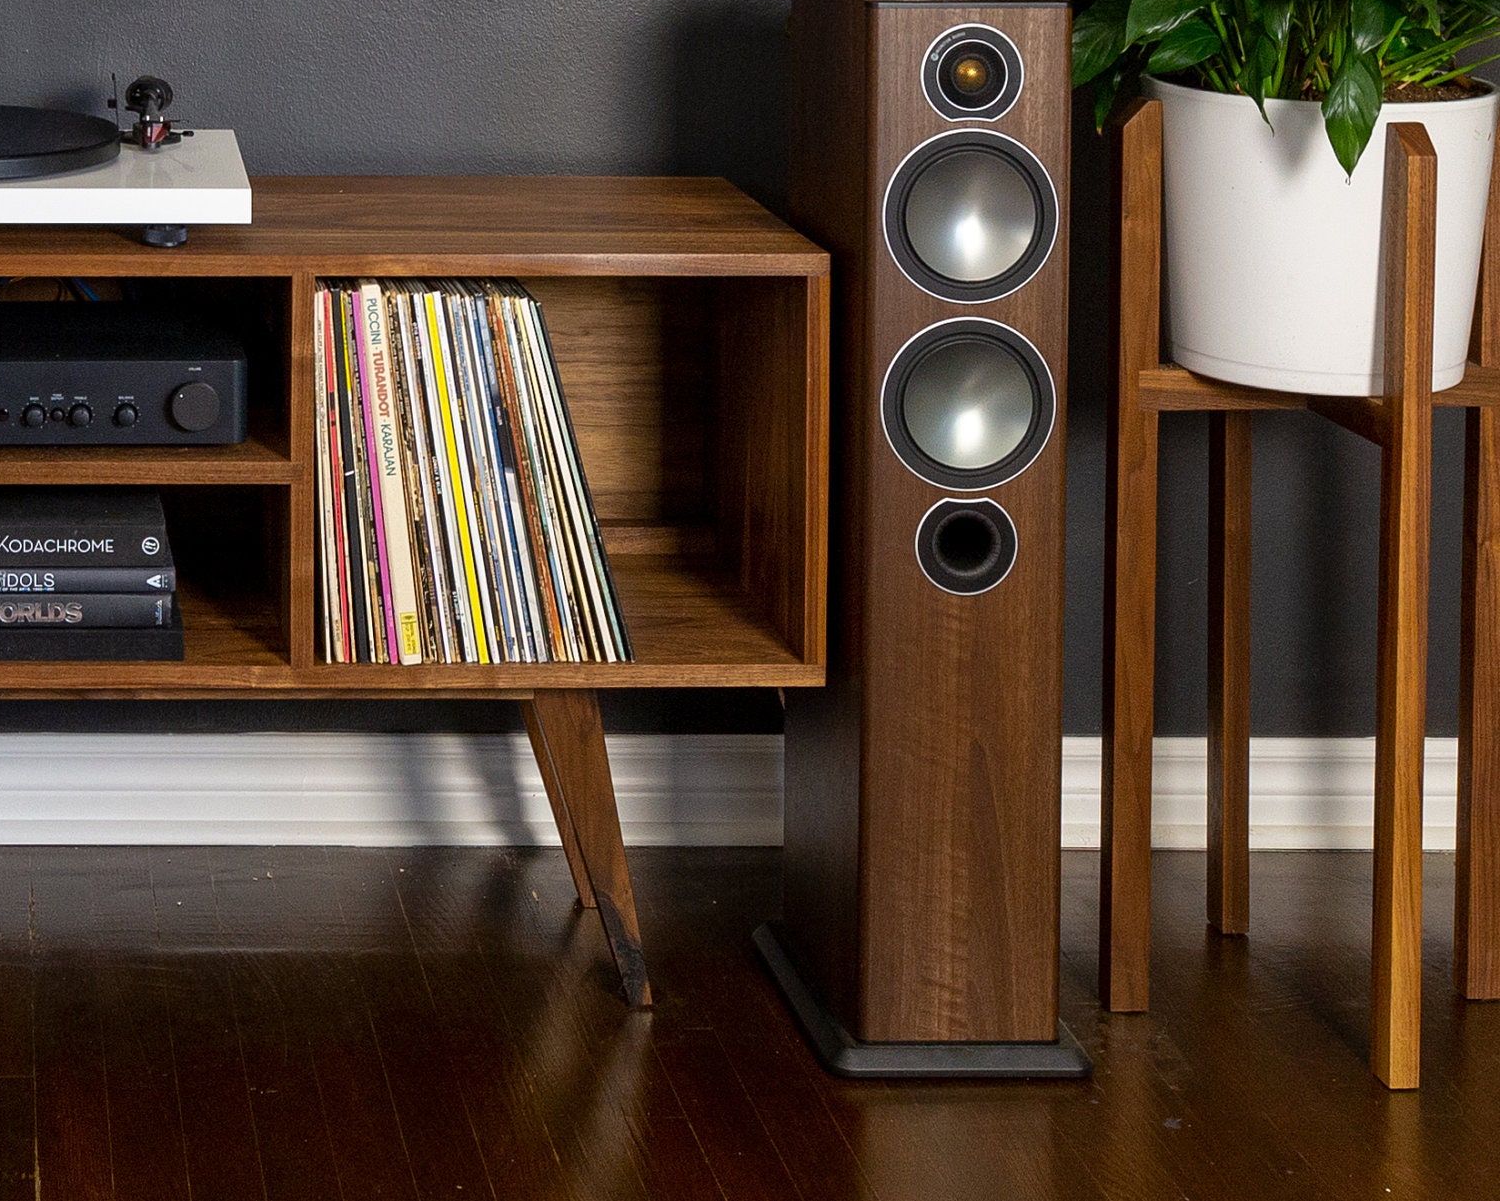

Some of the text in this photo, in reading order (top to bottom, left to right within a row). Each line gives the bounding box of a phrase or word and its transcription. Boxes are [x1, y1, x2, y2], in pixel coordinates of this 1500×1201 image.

[366, 297, 396, 476] PUCCINI TURANDOT KARAJAN
[2, 573, 55, 588] IDOLS
